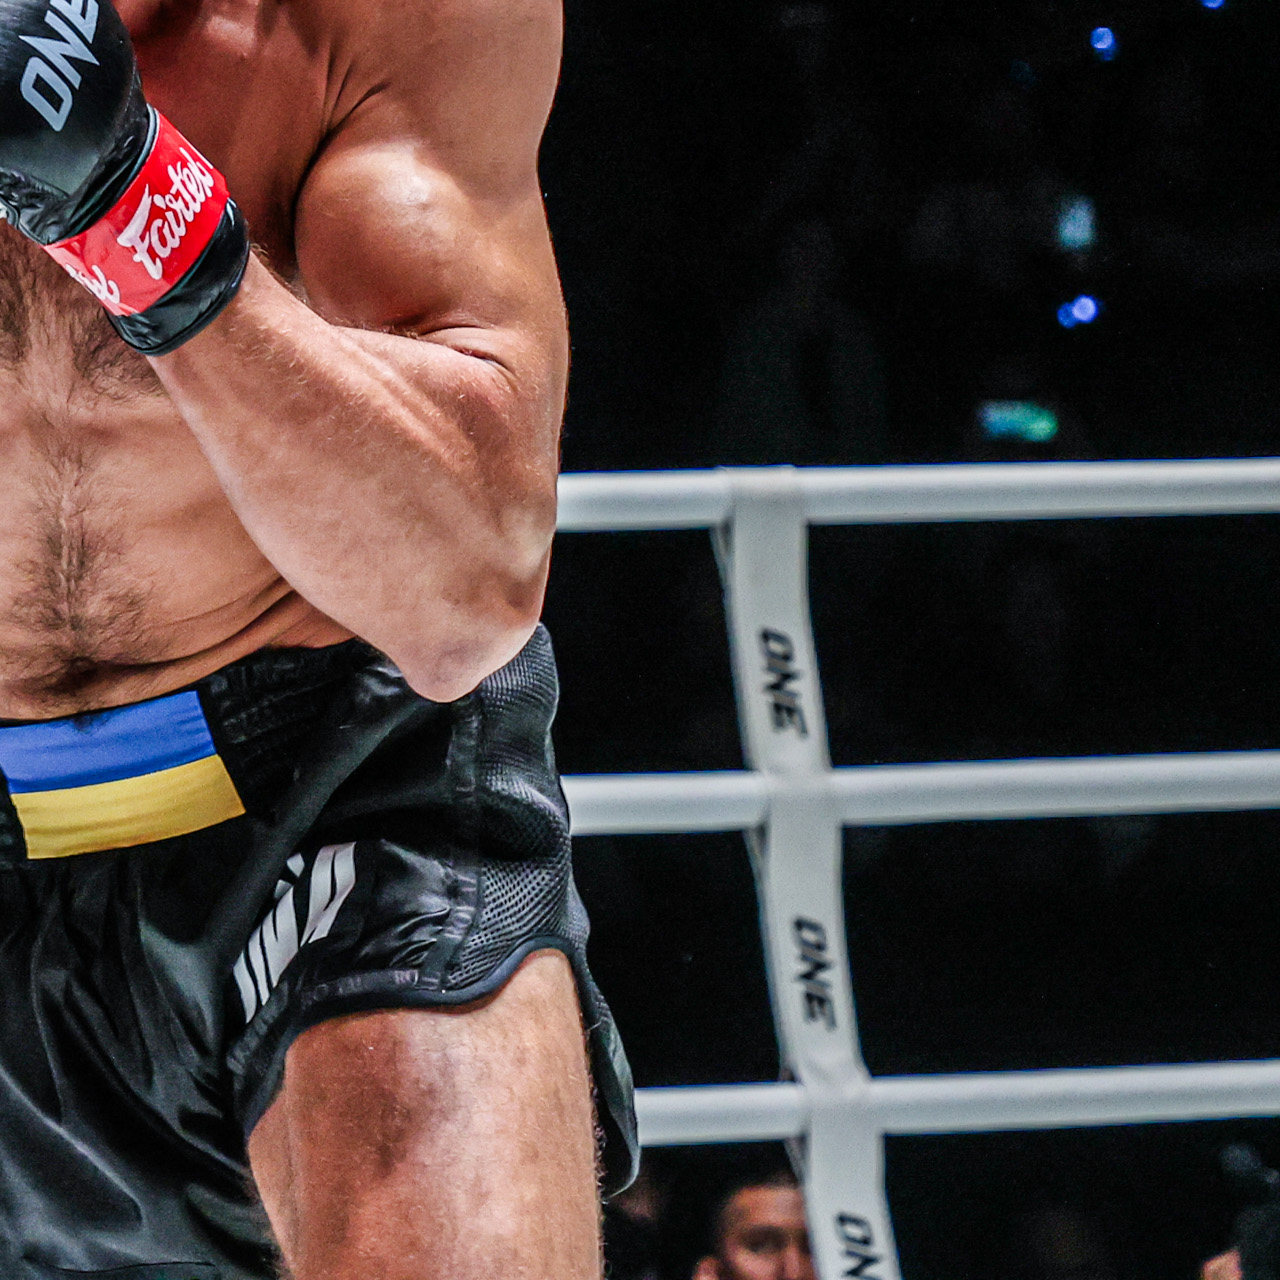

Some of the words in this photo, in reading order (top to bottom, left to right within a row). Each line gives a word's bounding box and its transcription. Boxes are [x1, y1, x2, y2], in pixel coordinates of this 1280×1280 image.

[116, 147, 214, 280] Fairtex
[761, 628, 808, 735] ONE
[794, 917, 836, 1029] ONE
[836, 1213, 881, 1280] ON
